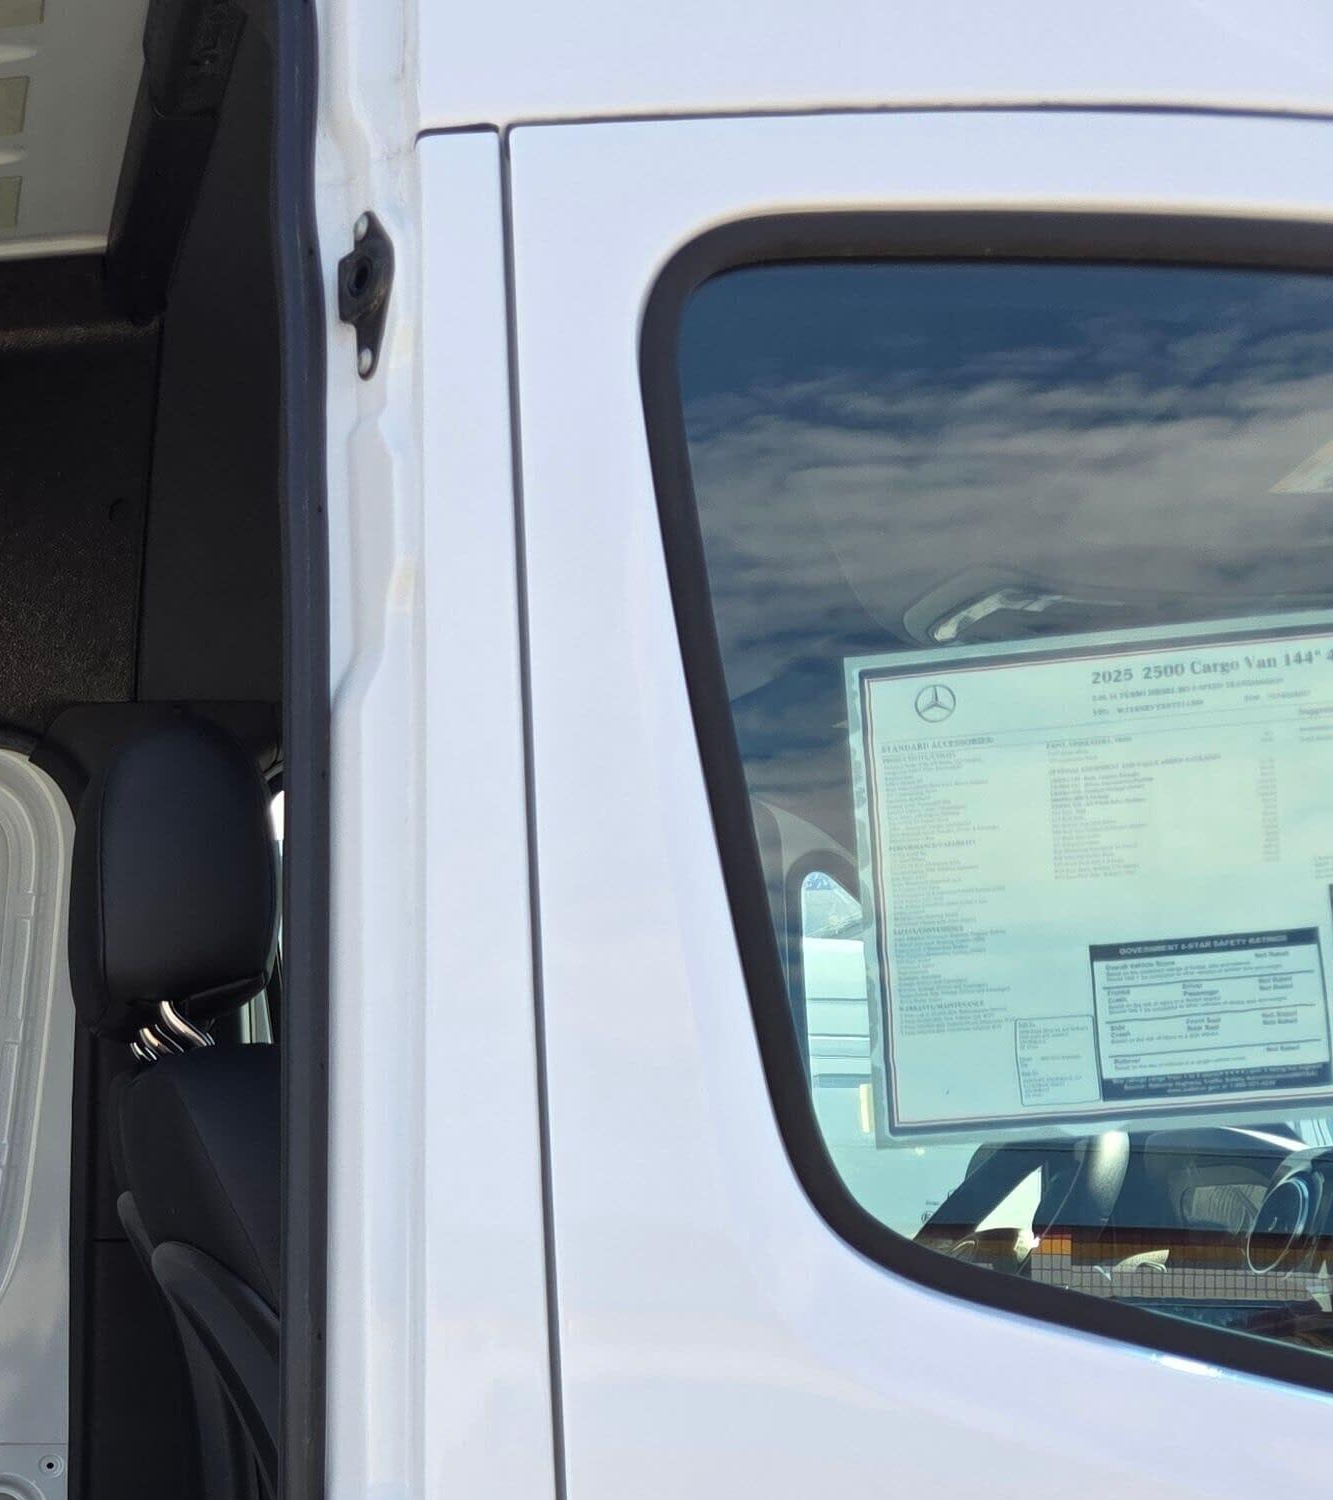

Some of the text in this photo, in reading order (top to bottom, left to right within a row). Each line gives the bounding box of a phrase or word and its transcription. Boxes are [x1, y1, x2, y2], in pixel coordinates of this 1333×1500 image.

[1091, 668, 1134, 685] 2025
[1142, 663, 1185, 680] 2500
[1190, 659, 1240, 676] Cargo
[1244, 654, 1277, 669] Van
[1283, 649, 1322, 666] 144"
[1119, 943, 1179, 956] GOVERNMENT
